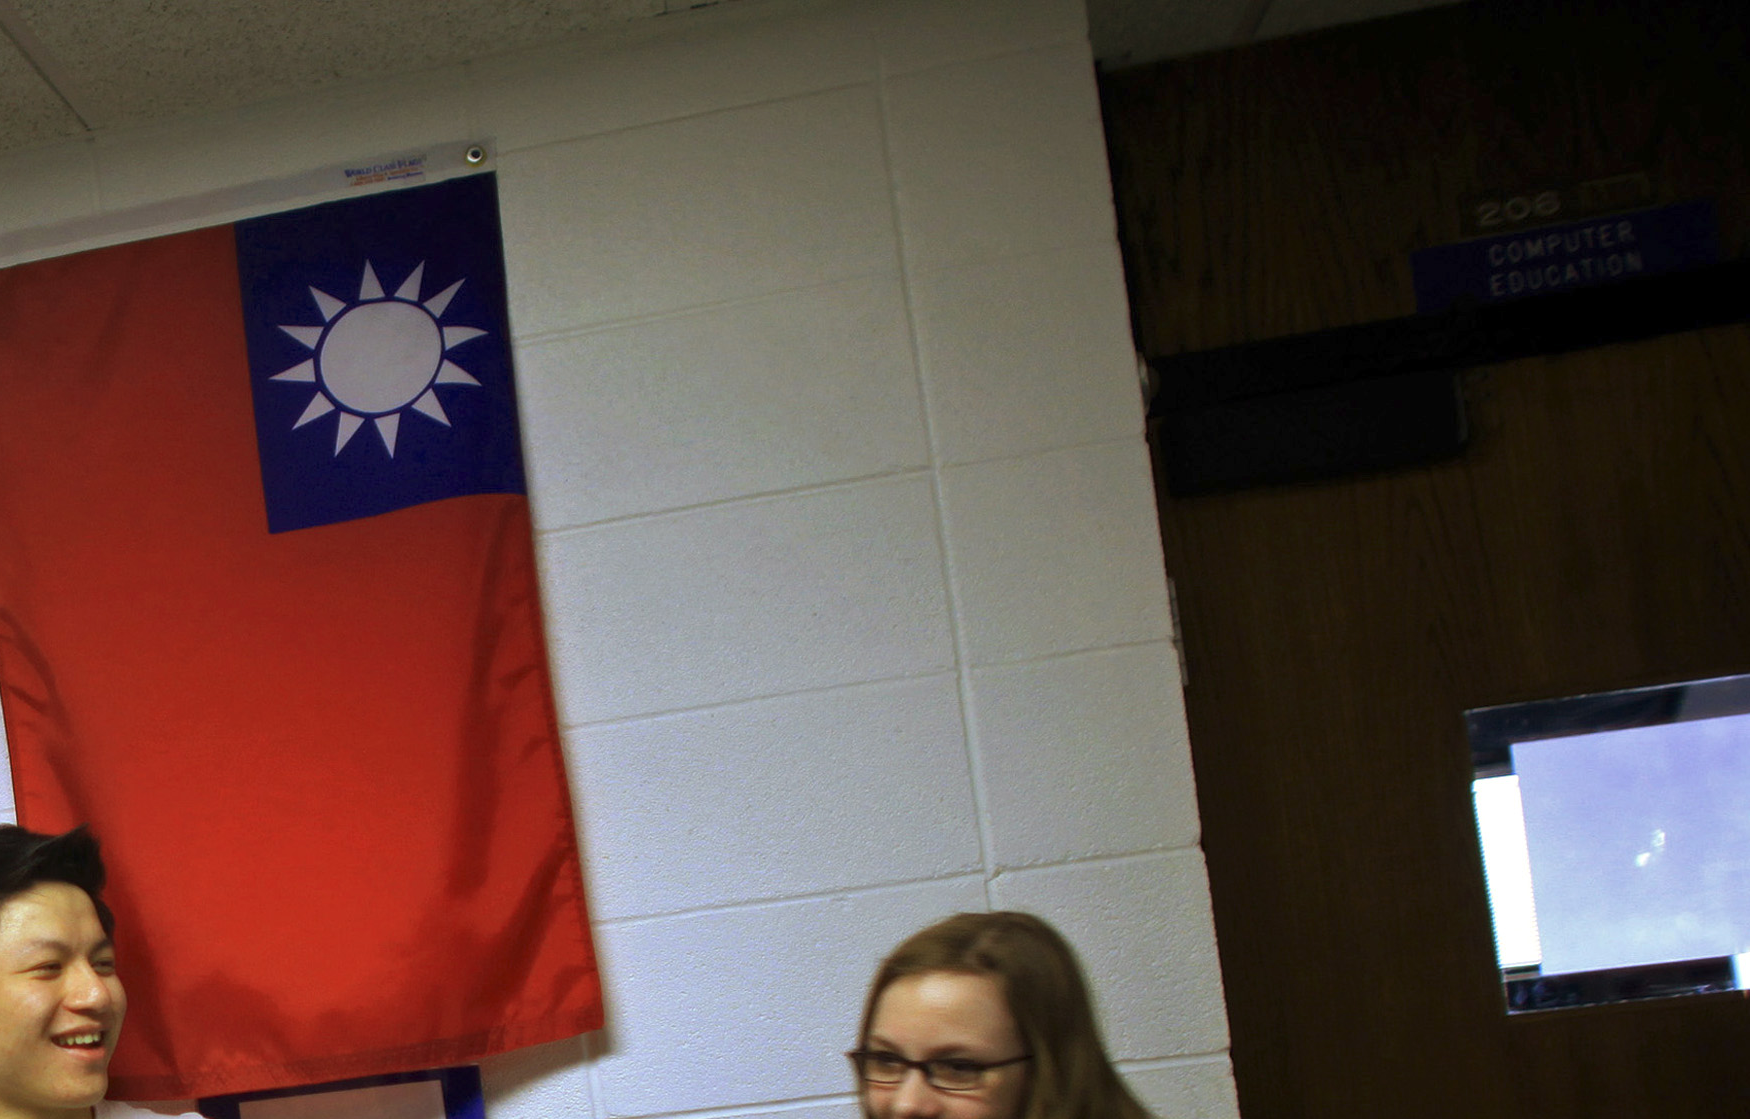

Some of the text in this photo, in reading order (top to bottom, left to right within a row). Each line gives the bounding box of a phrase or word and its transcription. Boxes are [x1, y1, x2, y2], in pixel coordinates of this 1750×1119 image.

[1477, 190, 1562, 226] 206
[1488, 220, 1635, 267] COMPUTER
[1489, 250, 1643, 297] EDUCATION
